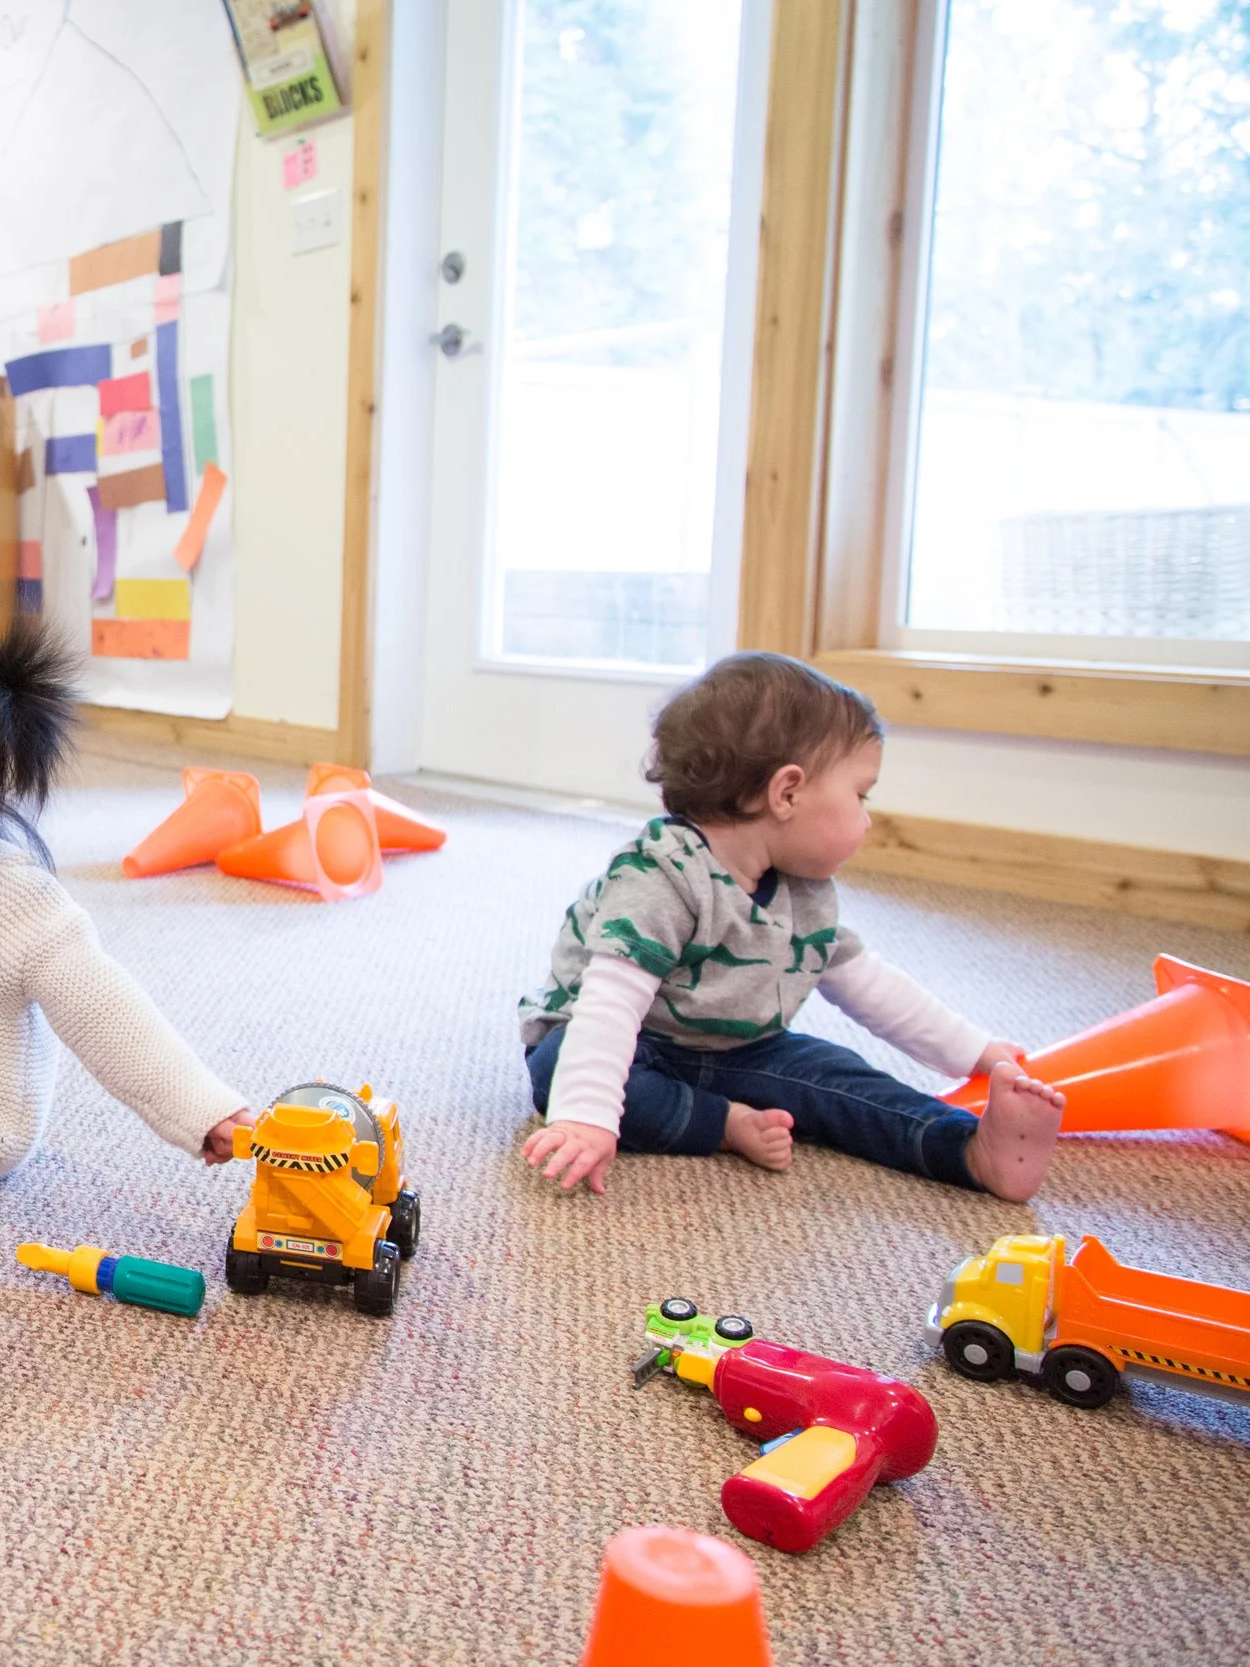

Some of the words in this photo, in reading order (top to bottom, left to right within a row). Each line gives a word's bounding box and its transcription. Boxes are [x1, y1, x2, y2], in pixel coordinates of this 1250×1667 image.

[262, 76, 323, 119] BLOCKS
[272, 1151, 300, 1161] CEMENT
[301, 1154, 323, 1163] MIXER
